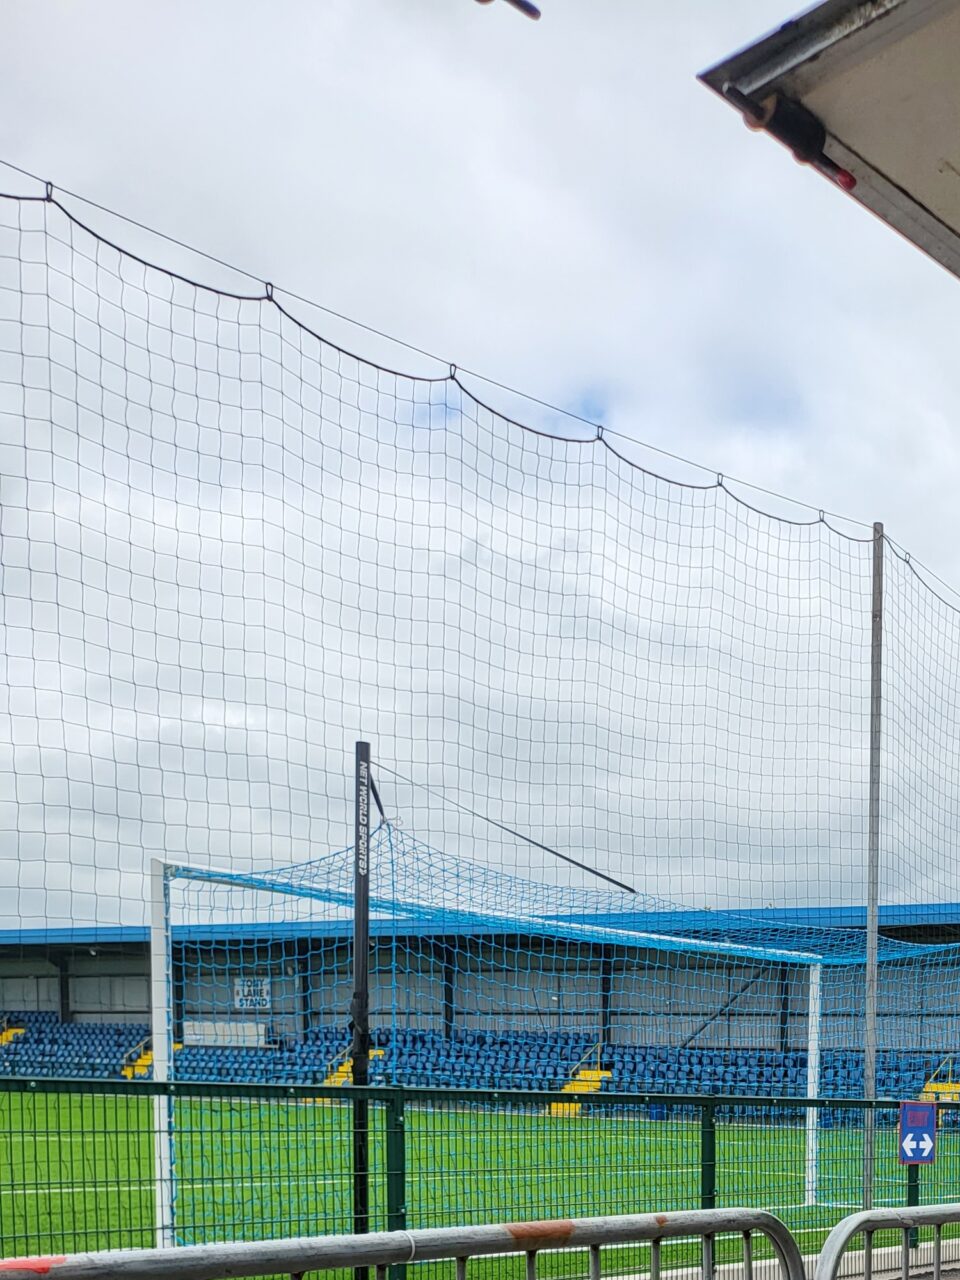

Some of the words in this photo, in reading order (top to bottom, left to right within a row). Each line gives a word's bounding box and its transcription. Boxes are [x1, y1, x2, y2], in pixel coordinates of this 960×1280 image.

[359, 761, 368, 785] NET
[358, 785, 368, 824] WORLD
[358, 825, 367, 868] SPORTS
[239, 998, 267, 1007] STAND
[241, 988, 264, 997] LANE
